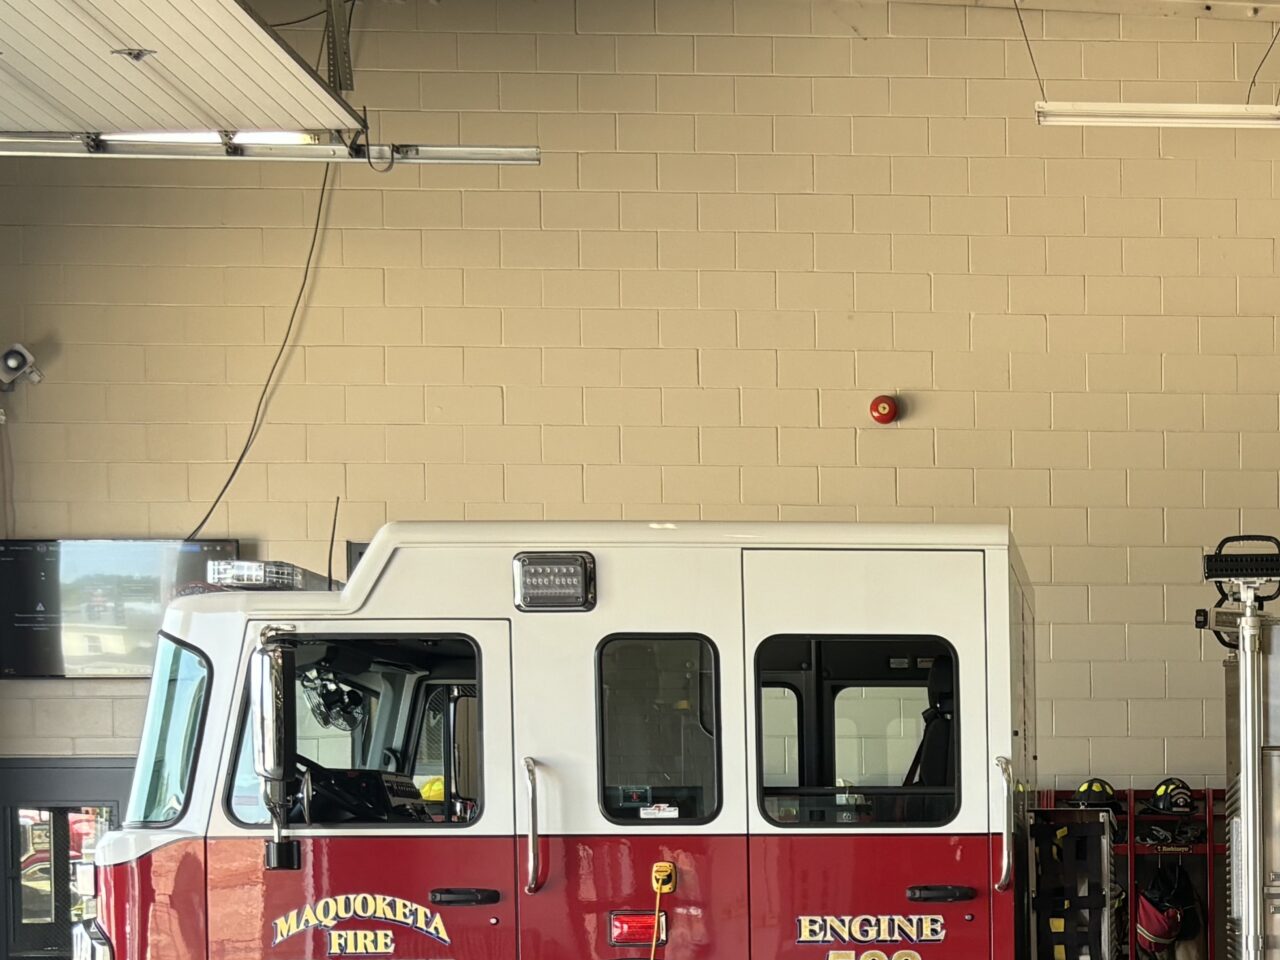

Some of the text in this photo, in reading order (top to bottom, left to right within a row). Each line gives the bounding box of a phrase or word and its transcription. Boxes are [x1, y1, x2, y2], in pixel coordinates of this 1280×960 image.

[272, 893, 451, 946] MAQUOKETA
[796, 915, 947, 943] ENGINE
[328, 930, 396, 955] FIRE
